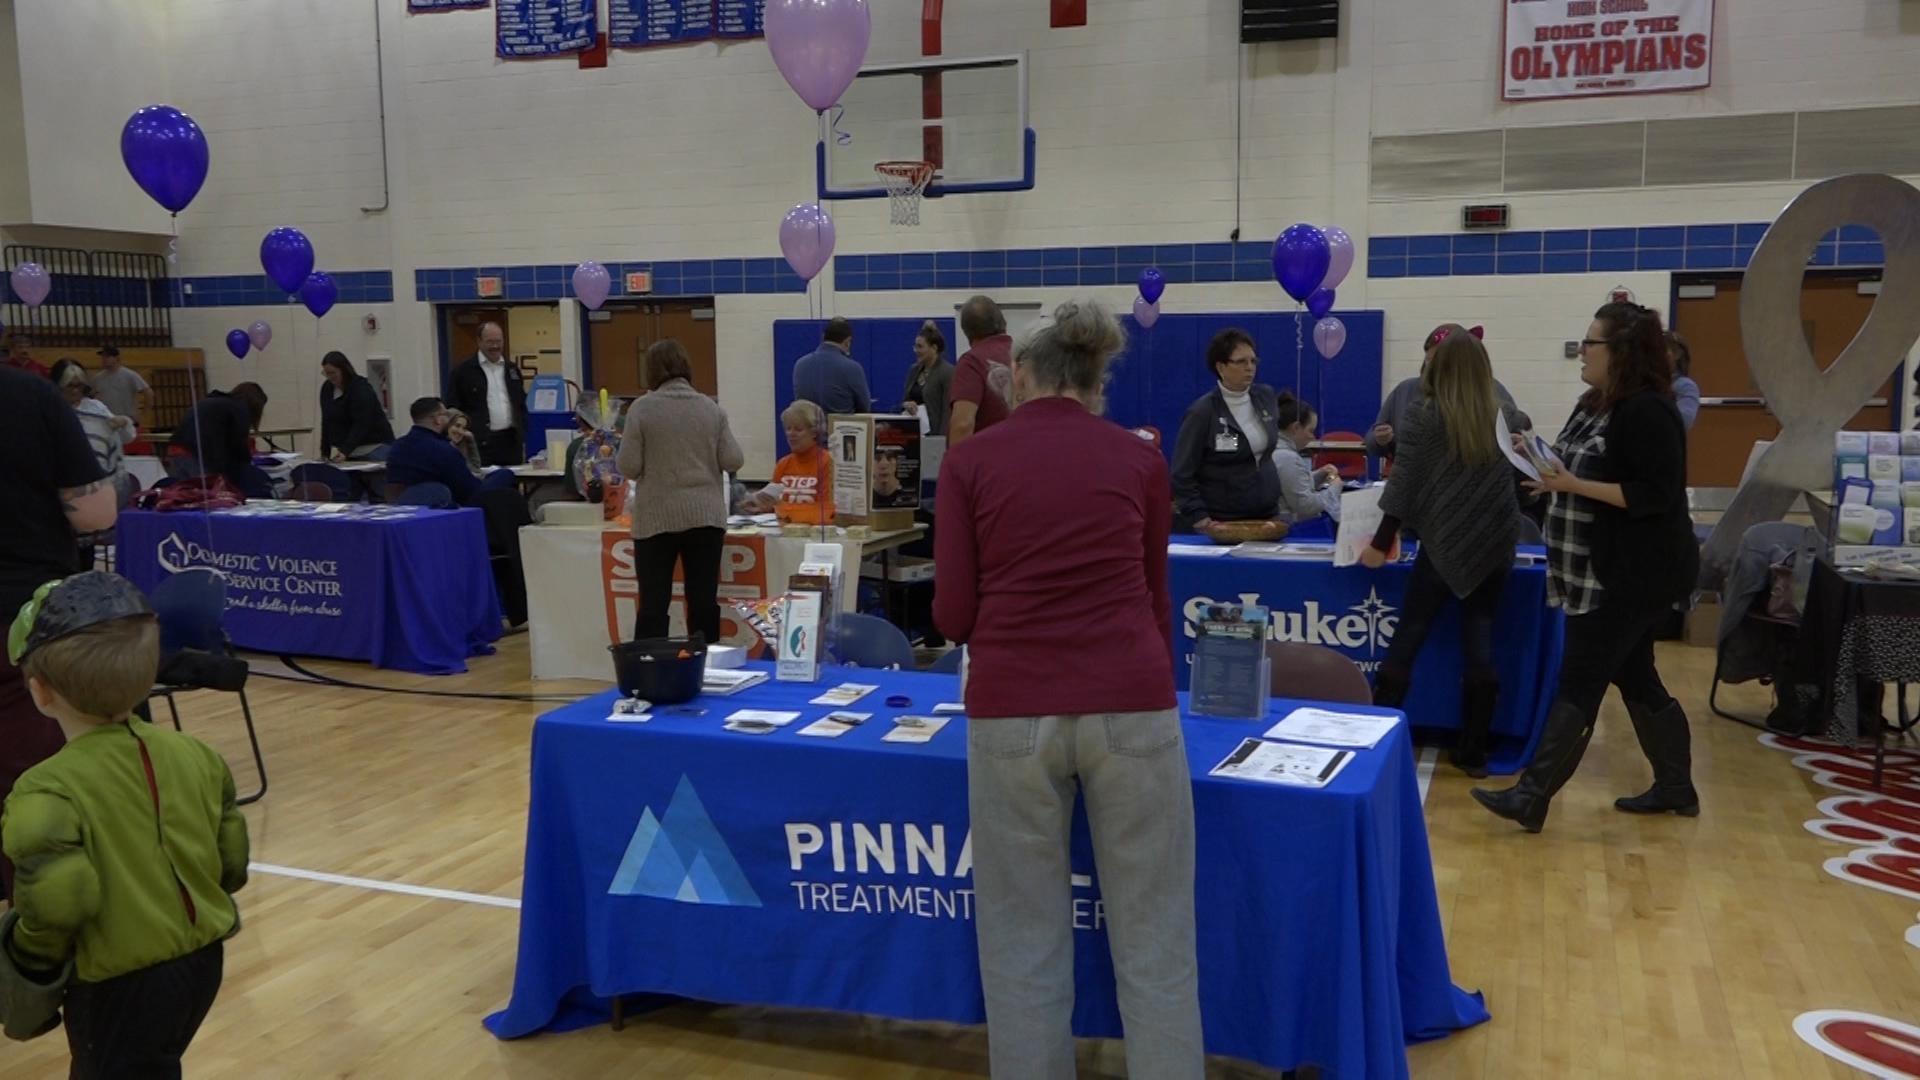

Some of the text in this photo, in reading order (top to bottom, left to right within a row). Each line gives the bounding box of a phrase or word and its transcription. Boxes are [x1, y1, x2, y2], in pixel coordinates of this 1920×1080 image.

[1535, 16, 1679, 42] HOME OF THE
[1510, 33, 1706, 81] OLYMPIANS
[187, 541, 338, 577] DOMESTIC VIOLENCE
[611, 539, 756, 583] SP
[226, 571, 342, 597] SERVICE CENTER
[789, 880, 976, 921] TREATMENT
